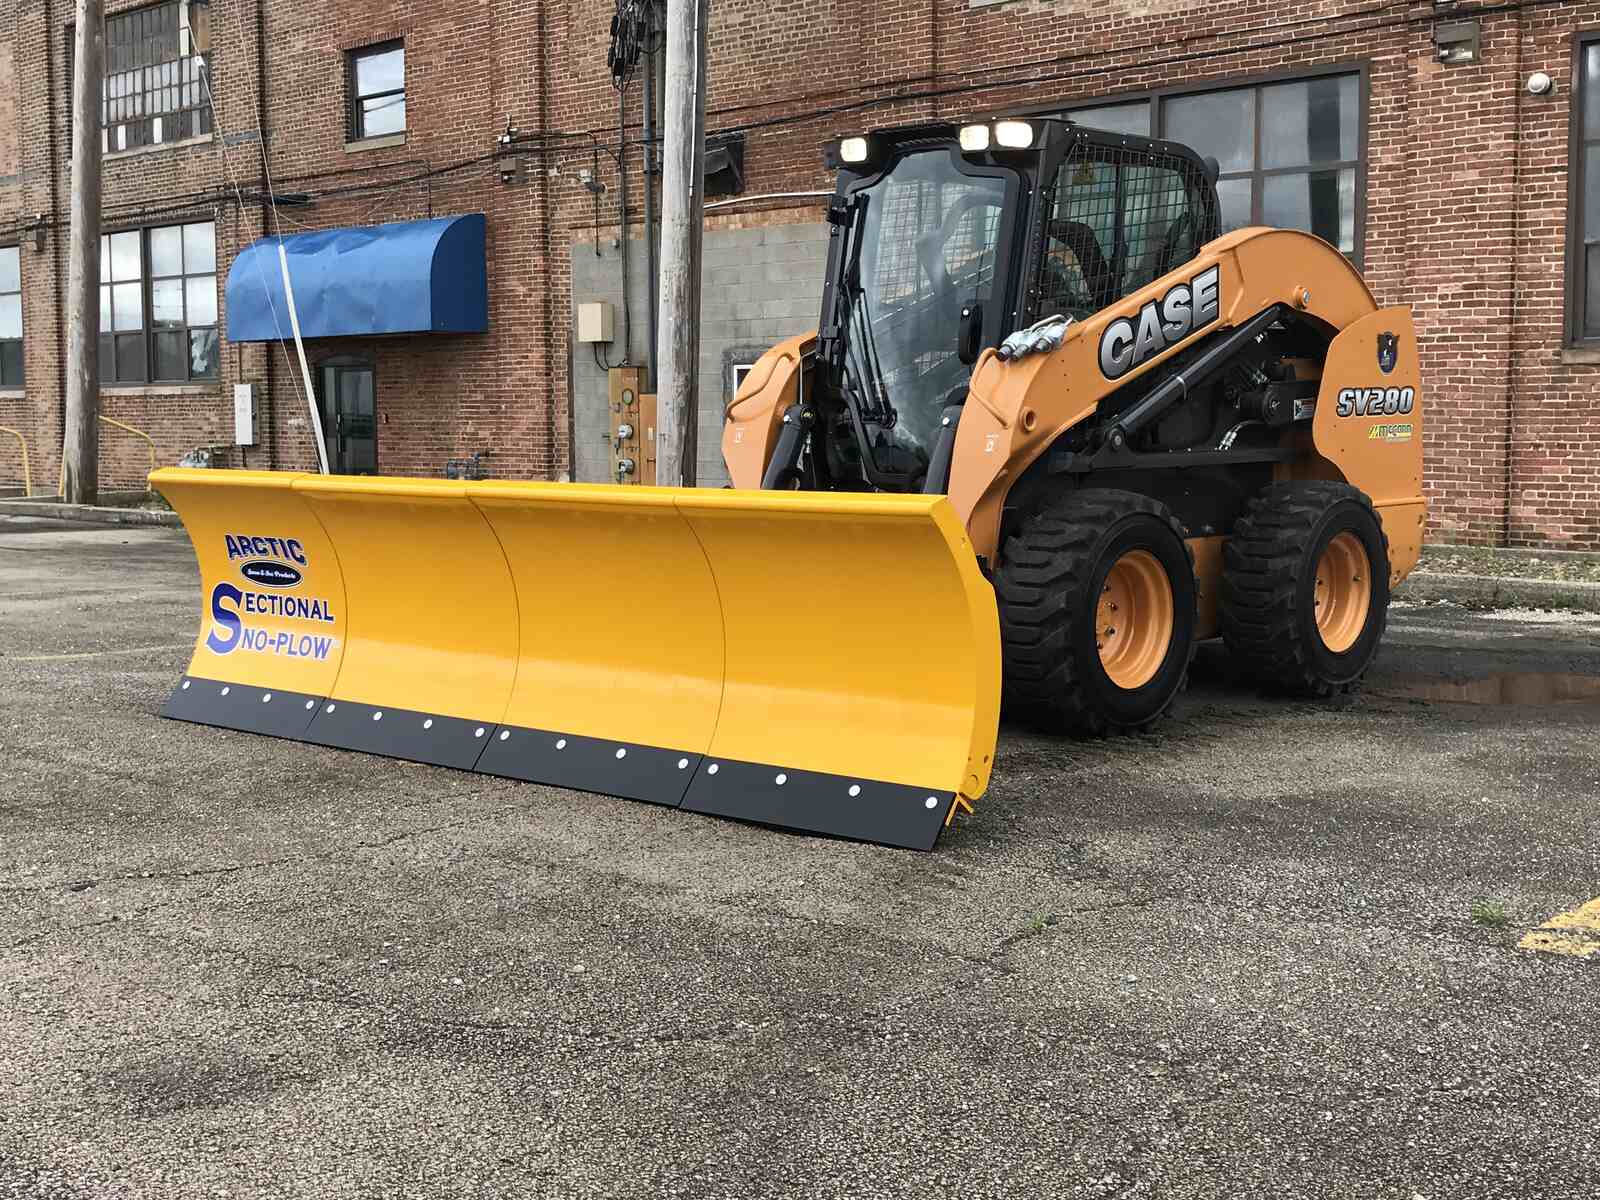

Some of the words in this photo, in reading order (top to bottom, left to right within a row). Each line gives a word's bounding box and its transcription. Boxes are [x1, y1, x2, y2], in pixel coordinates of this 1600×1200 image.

[1099, 265, 1219, 378] CASE
[1337, 387, 1415, 417] SV280
[225, 534, 307, 565] ARCTIC
